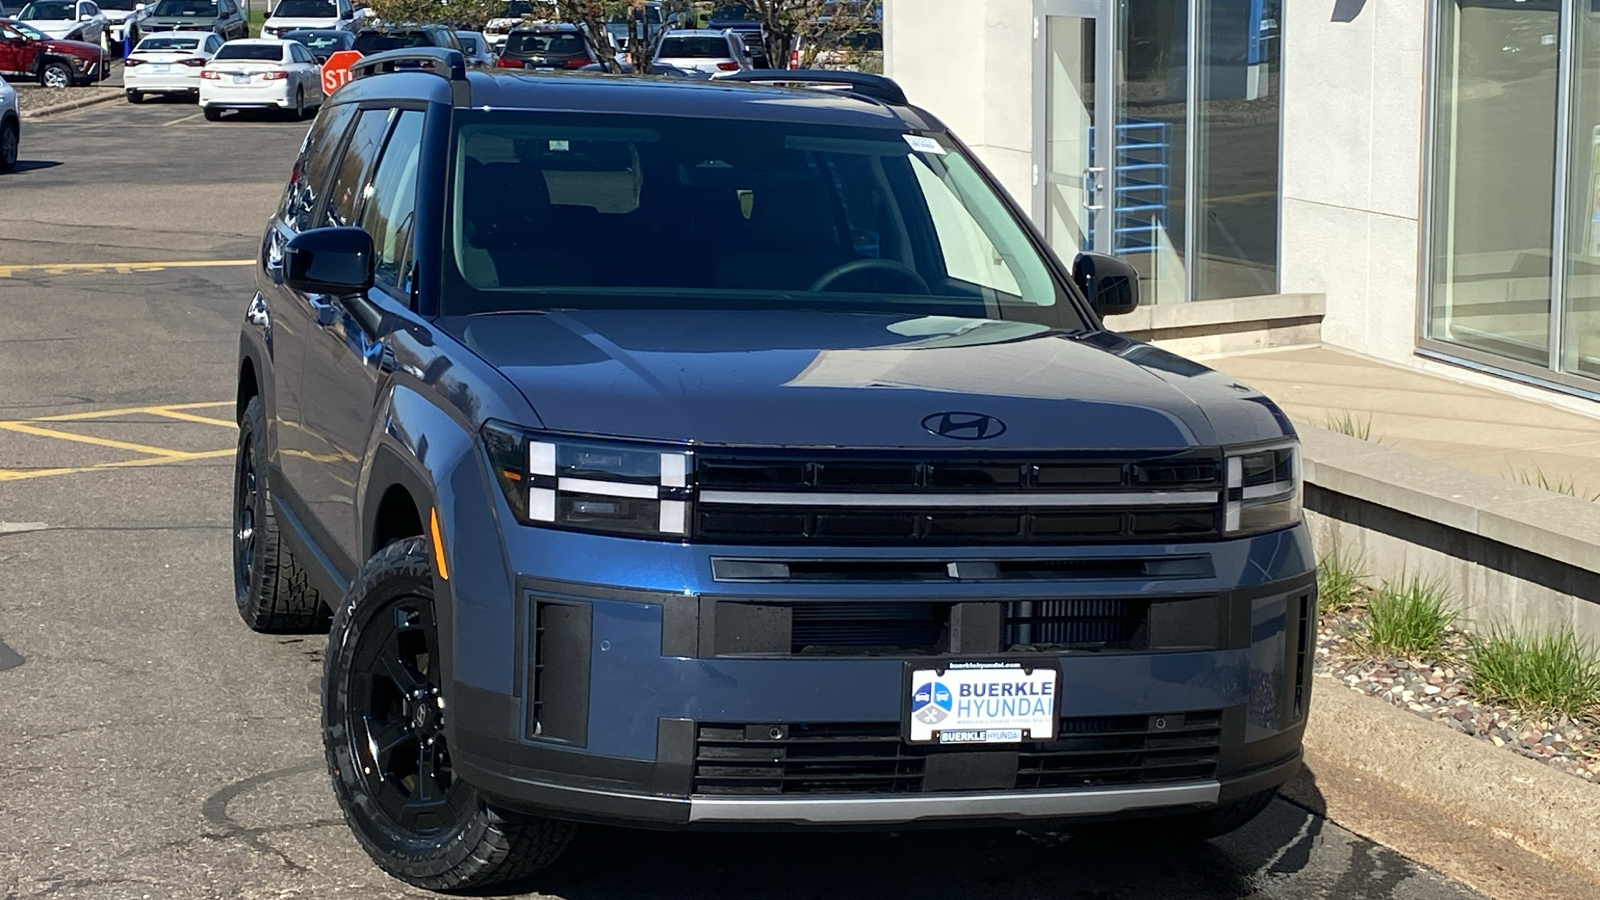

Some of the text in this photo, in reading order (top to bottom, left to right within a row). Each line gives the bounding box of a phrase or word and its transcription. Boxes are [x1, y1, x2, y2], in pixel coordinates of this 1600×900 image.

[325, 69, 353, 89] ST
[960, 682, 1052, 697] BUERKLE
[958, 698, 1052, 717] HYUNDAI
[942, 731, 1020, 741] BUERKLE HYUNDAI
